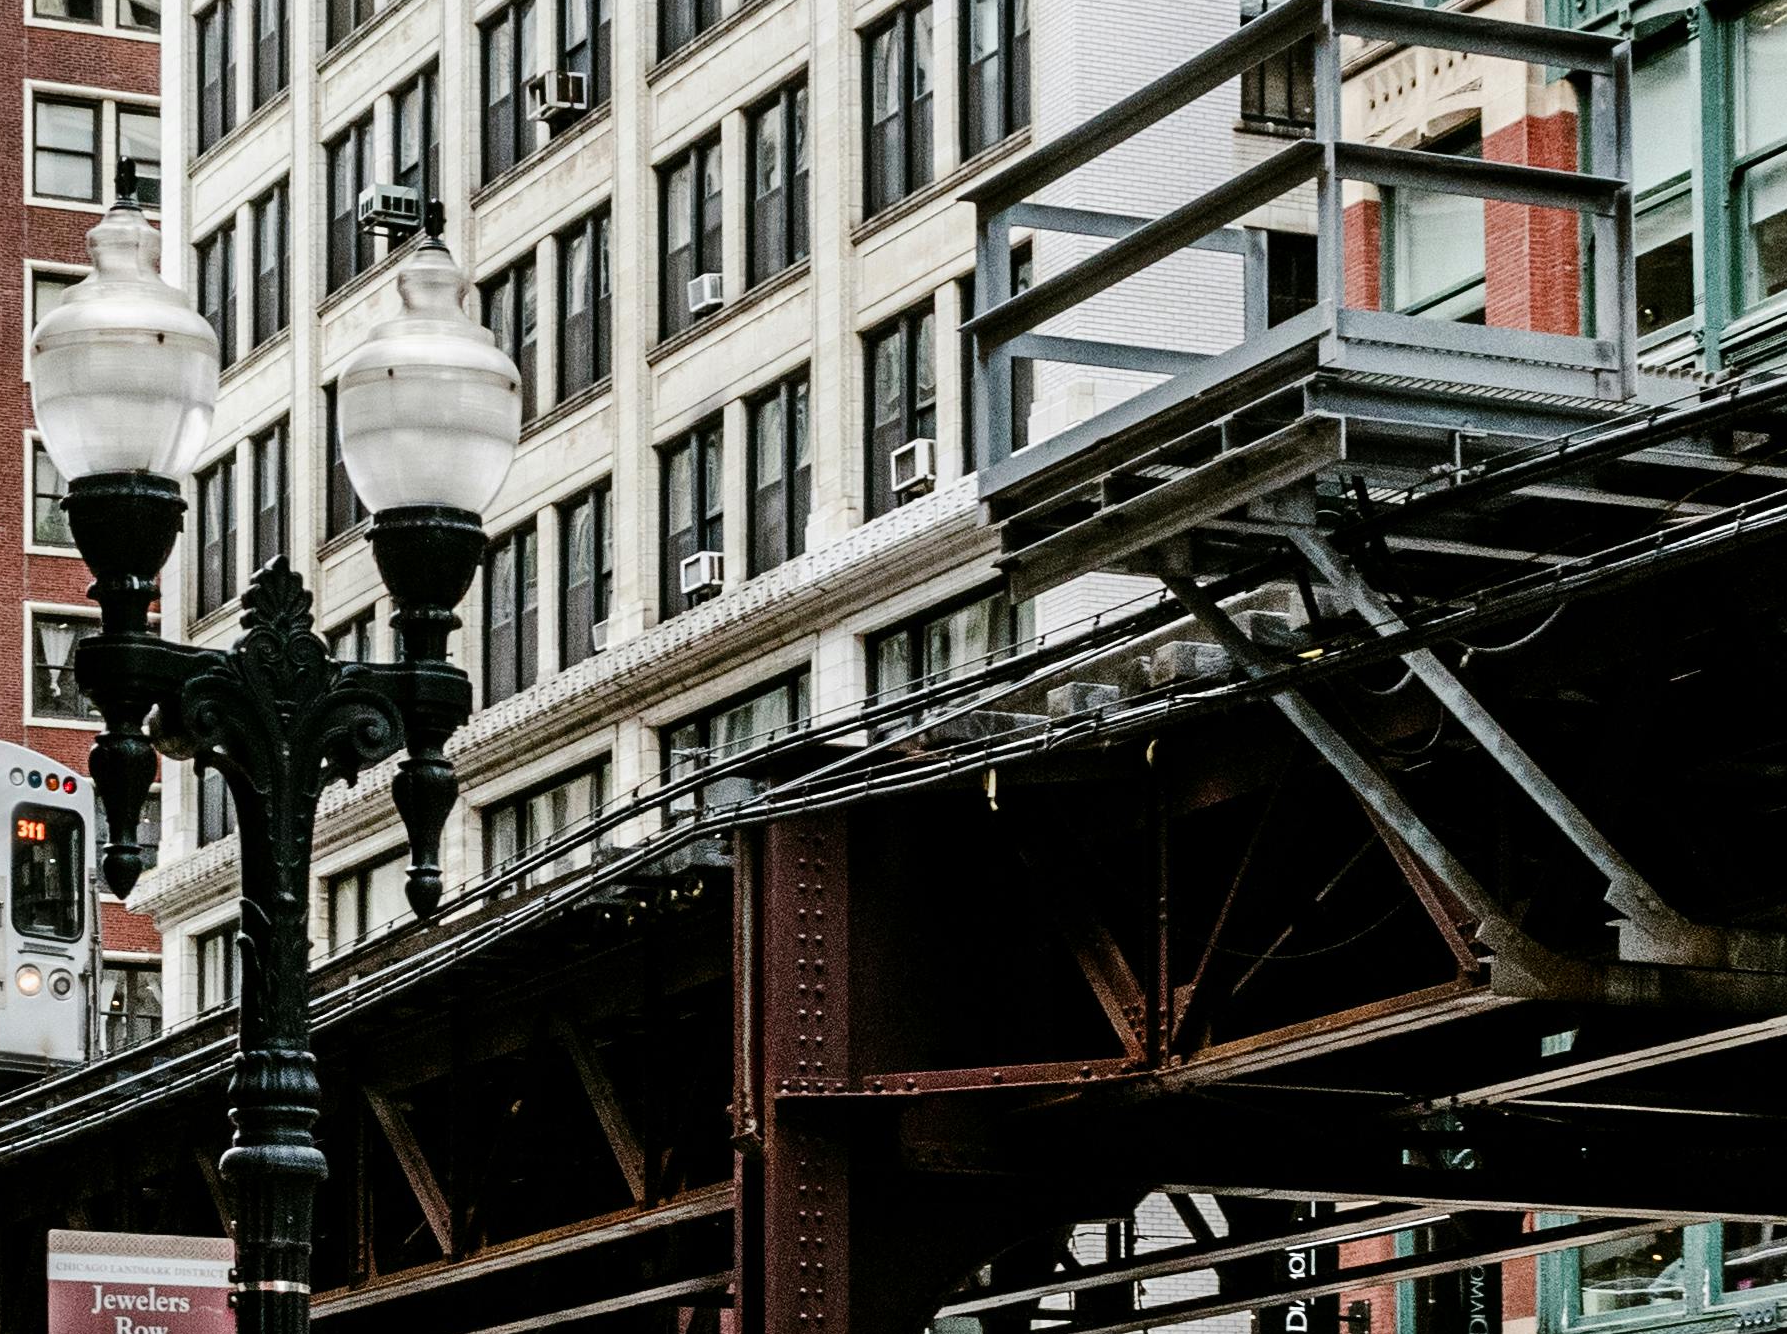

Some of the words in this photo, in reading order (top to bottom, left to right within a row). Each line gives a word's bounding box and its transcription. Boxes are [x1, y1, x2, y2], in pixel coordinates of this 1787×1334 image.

[55, 1261, 108, 1273] CHICAGO
[111, 1264, 171, 1276] LANDMARK
[175, 1267, 225, 1279] DISTRICT
[91, 1284, 191, 1315] Jewelers
